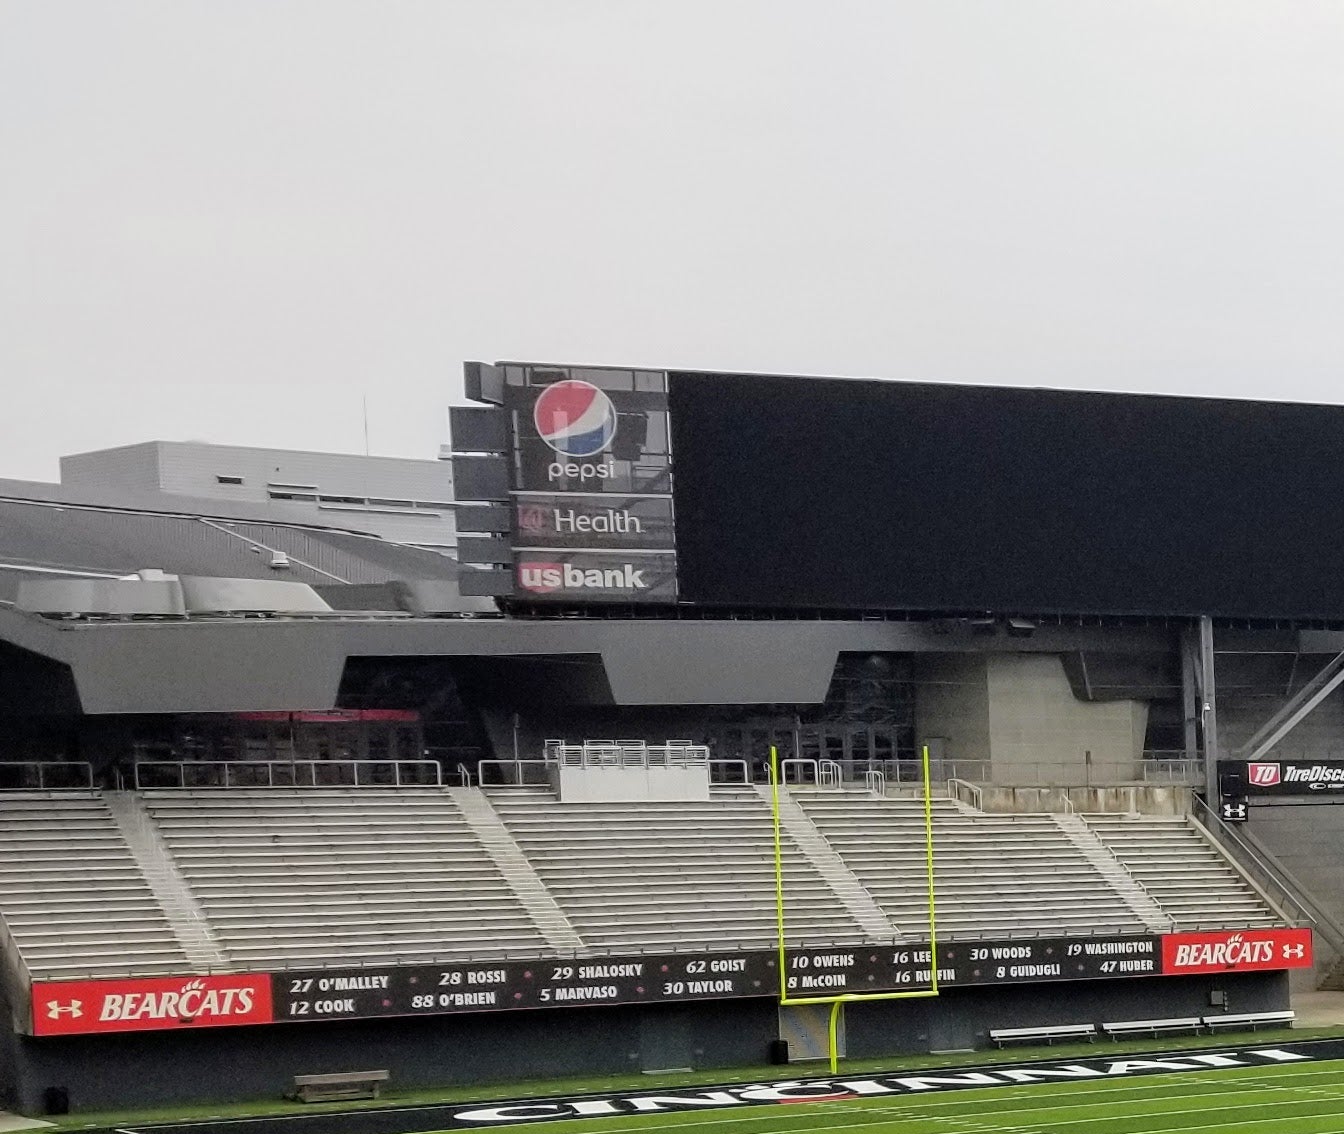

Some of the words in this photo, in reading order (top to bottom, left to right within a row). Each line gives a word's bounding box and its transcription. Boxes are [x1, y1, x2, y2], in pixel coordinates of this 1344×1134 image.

[548, 460, 615, 483] pepsi
[554, 509, 642, 534] Health
[520, 563, 646, 589] usbank
[1254, 766, 1278, 782] TD
[969, 948, 989, 961] 30
[991, 946, 1032, 960] WOODS
[1066, 943, 1082, 956] 19
[1084, 940, 1154, 955] WASHINGTON
[1174, 936, 1275, 967] BEARCATS
[791, 955, 809, 969] 10
[813, 954, 855, 968] OWENS
[892, 951, 909, 964] 16
[913, 950, 932, 963] LEE
[550, 966, 574, 981] 29
[578, 963, 644, 979] SHALOSKY
[685, 960, 706, 974] 62
[710, 958, 747, 972] GOIST
[996, 966, 1006, 979] 8
[1009, 963, 1061, 978] GUIDUGLI
[1099, 960, 1118, 974] 47
[1119, 959, 1154, 972] HUBER
[289, 978, 313, 993] 27
[318, 975, 390, 992] O'MALLEY
[438, 971, 462, 986] 28
[467, 969, 506, 984] ROSSI
[787, 976, 798, 990] 8
[894, 970, 911, 983] 16
[539, 987, 552, 1002] 5
[555, 985, 618, 1001] MARVASO
[662, 981, 684, 996] 30
[686, 979, 734, 994] TAYLOR
[98, 982, 256, 1022] BEARCATS
[289, 1001, 309, 1015] 12
[314, 998, 355, 1014] COOK
[411, 994, 434, 1009] 88
[439, 991, 497, 1007] O'BRIEN
[453, 1049, 1314, 1122] CINCINNATI
